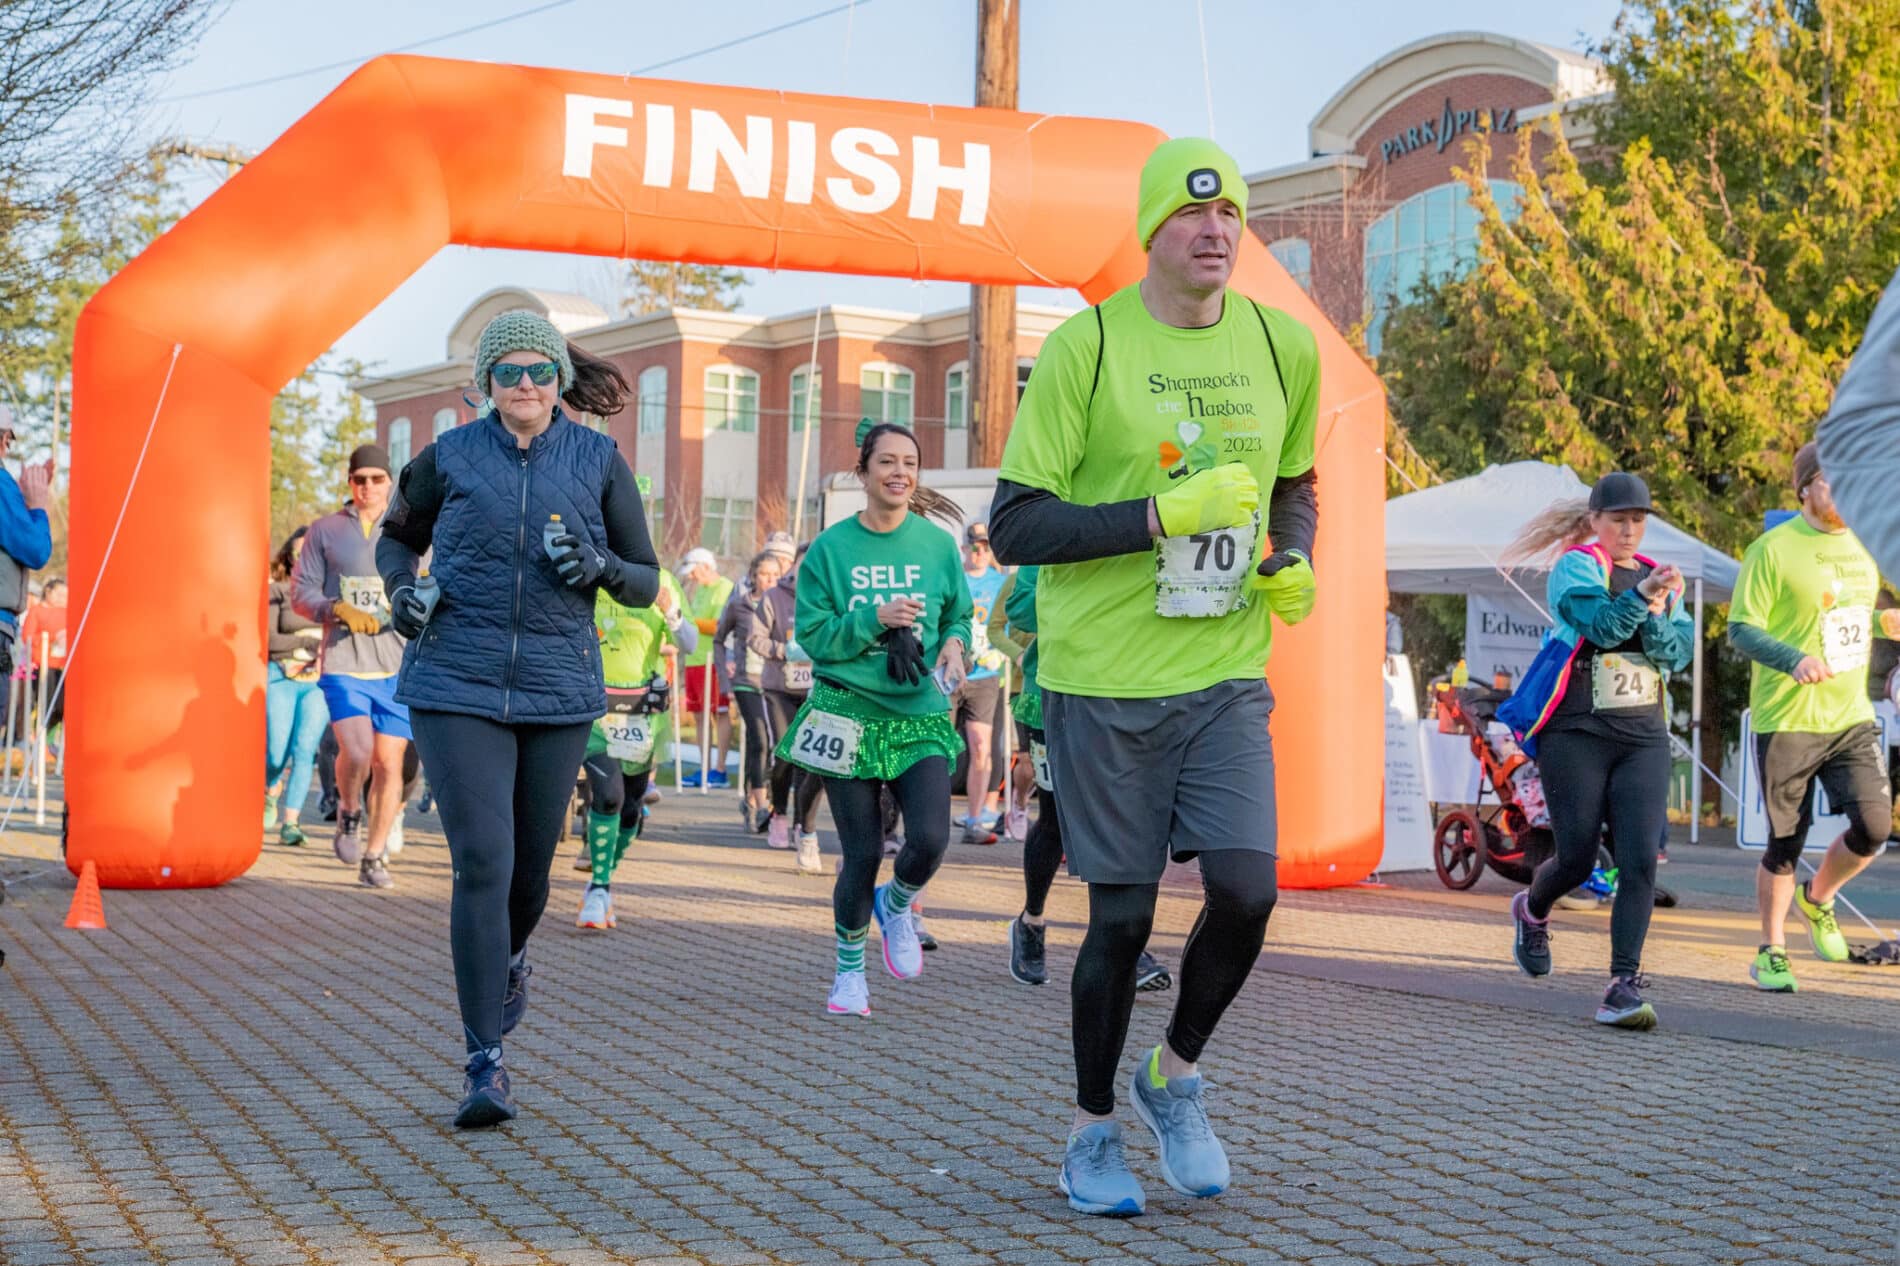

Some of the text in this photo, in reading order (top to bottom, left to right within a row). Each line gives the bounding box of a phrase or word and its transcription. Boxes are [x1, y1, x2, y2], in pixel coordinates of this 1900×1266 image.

[1381, 107, 1523, 163] PARK PLAZ
[563, 93, 992, 227] FINISH
[1223, 437, 1262, 452] 2023
[1189, 533, 1236, 571] 70
[851, 564, 921, 589] SELF
[350, 591, 381, 606] 137
[1838, 624, 1861, 646] 32
[1614, 671, 1643, 696] 24
[609, 727, 643, 742] 229
[799, 728, 844, 761] 249
